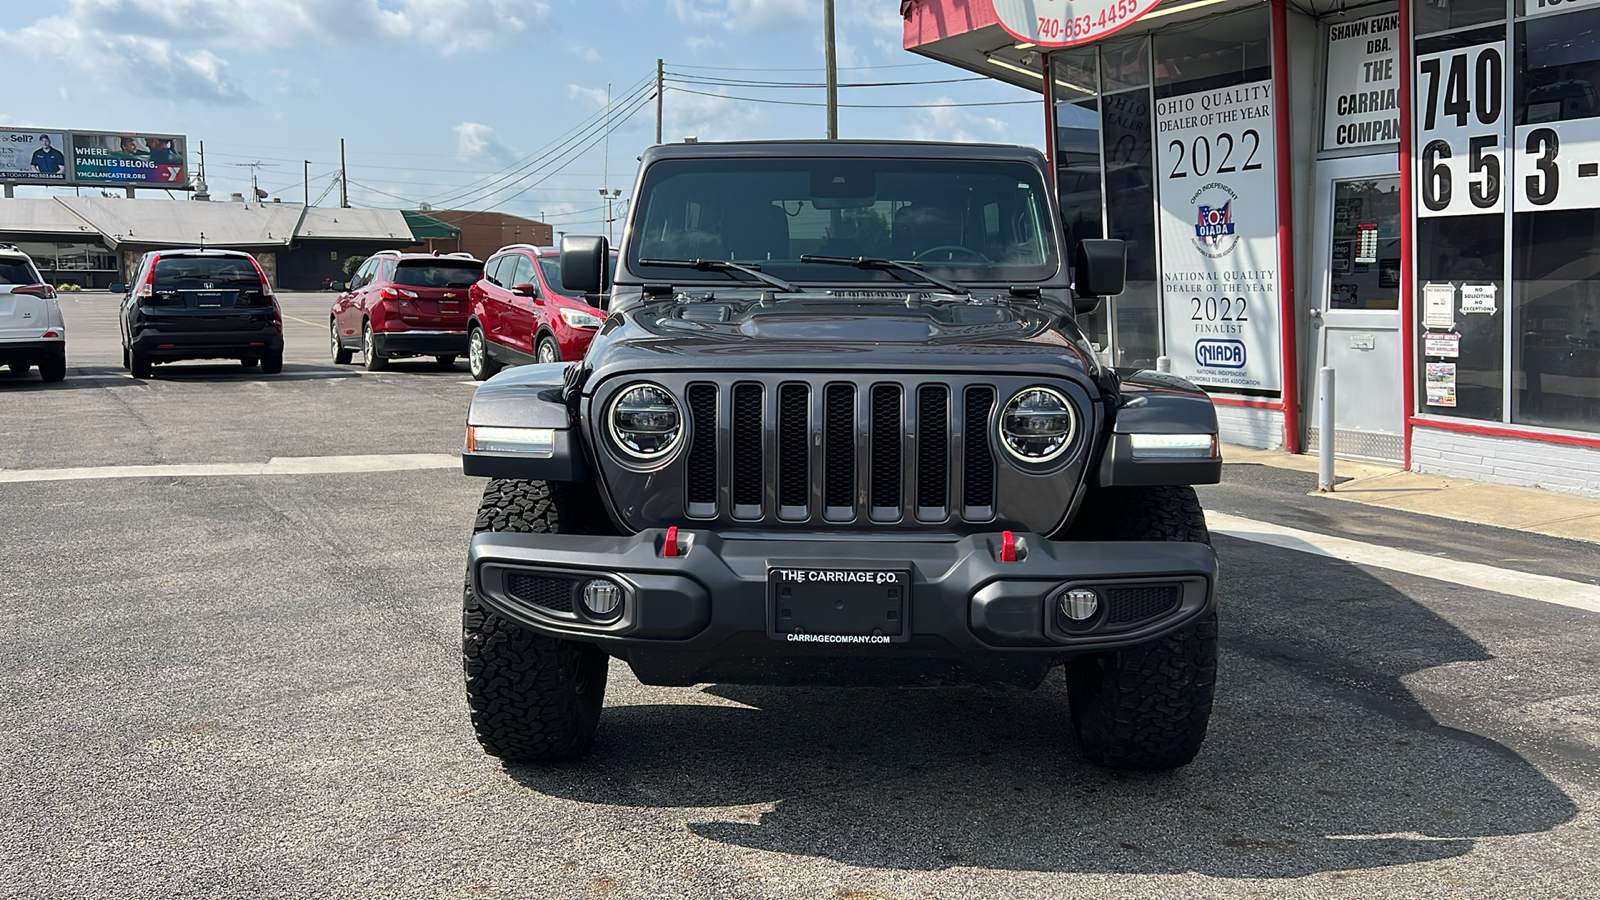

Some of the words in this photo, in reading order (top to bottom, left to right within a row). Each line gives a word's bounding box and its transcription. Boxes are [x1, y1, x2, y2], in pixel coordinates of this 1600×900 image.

[1037, 0, 1137, 38] 740-653-4455
[1331, 20, 1369, 41] SHAWN
[1370, 15, 1400, 34] EVAN
[1366, 38, 1391, 54] DBA.
[1363, 58, 1393, 83] THE
[1420, 47, 1502, 131] 740
[1158, 98, 1194, 116] OHIO
[1201, 84, 1271, 110] QUALITY
[1337, 88, 1400, 116] CARRIA
[1159, 116, 1198, 132] DEALER
[1200, 113, 1214, 126] OF
[1216, 110, 1238, 124] THE
[1240, 104, 1270, 120] YEAR
[10, 134, 33, 143] Sell?
[1336, 118, 1400, 145] COMPAN
[75, 147, 108, 156] WHERE
[1169, 129, 1262, 179] 2022
[76, 158, 118, 167] FAMILIES
[119, 160, 158, 169] BELONG.
[77, 171, 146, 180] YMCALANCASTER.ORG
[1190, 188, 1203, 204] OHIO
[1202, 182, 1238, 201] INDEPENDENT
[1199, 224, 1229, 236] OIADA
[1165, 271, 1219, 281] NATIONAL
[1223, 270, 1274, 282] QUALITY
[1166, 284, 1202, 293] DEALER
[1206, 284, 1218, 292] OF
[1222, 283, 1242, 292] THE
[1245, 283, 1274, 292] YEAR
[1190, 296, 1248, 322] 2022
[1195, 324, 1243, 334] FINALIST
[1199, 345, 1242, 363] NIADA
[780, 570, 806, 582] THE
[808, 571, 874, 582] CARRIAGE
[876, 572, 899, 584] CO.
[787, 633, 891, 643] CARRIAGECOMPANY.COM
